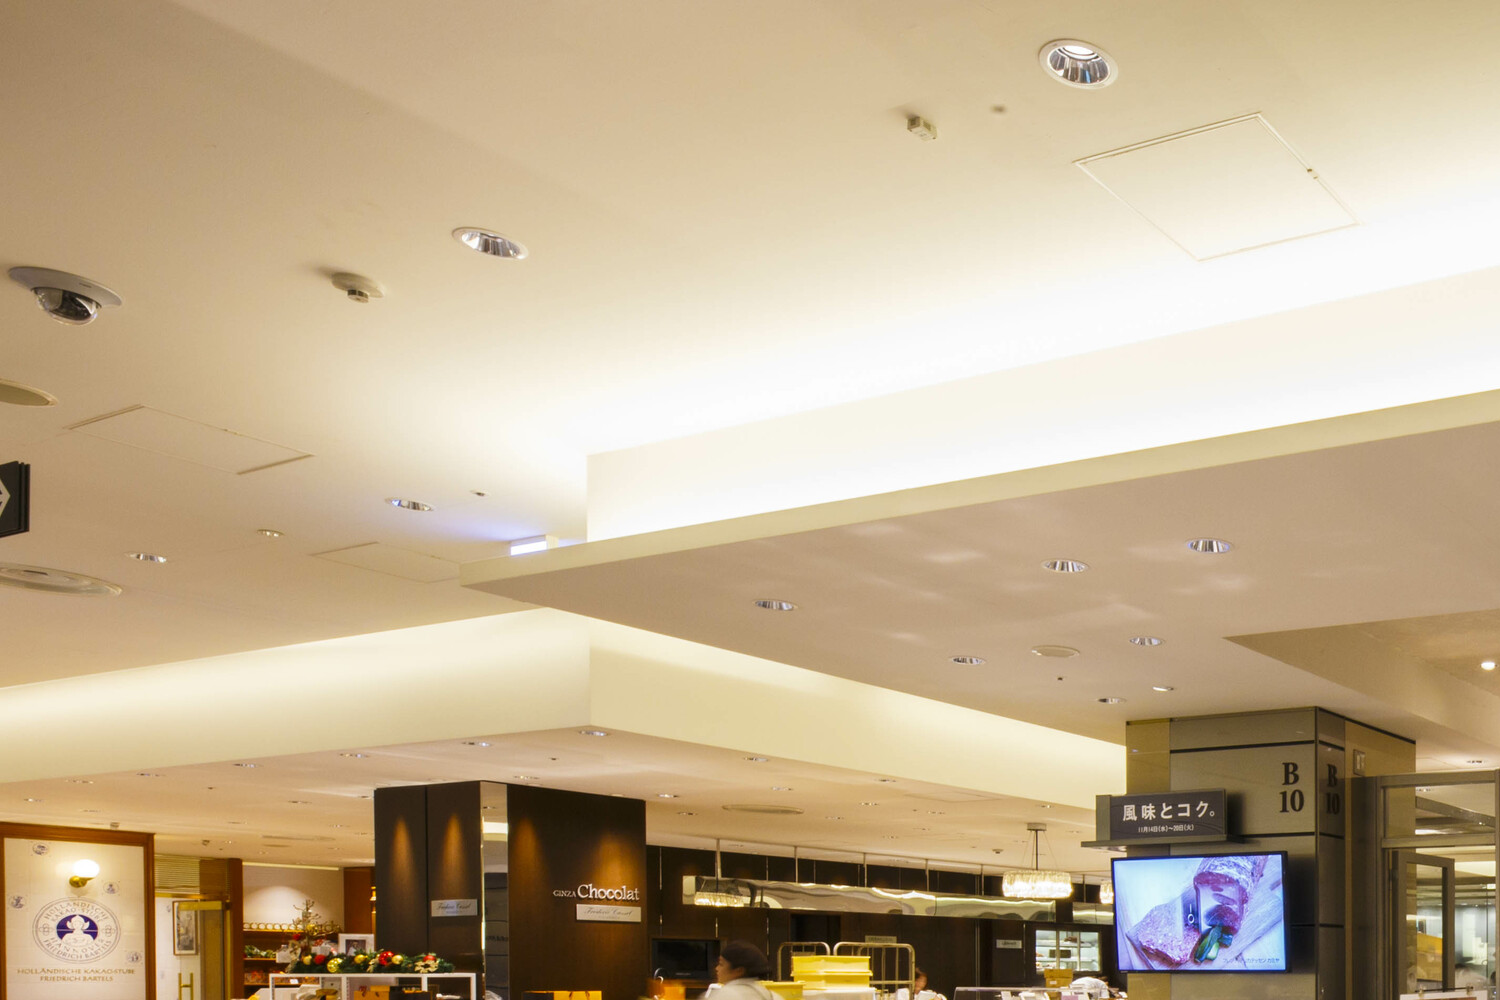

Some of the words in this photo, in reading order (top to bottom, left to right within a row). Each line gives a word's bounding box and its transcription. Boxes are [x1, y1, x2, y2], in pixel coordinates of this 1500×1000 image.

[1281, 761, 1300, 786] B
[1326, 763, 1339, 788] B
[1122, 800, 1216, 822] 風味とコク。
[1279, 789, 1305, 813] 10
[552, 889, 577, 898] GINZA
[577, 883, 640, 901] Chocolat
